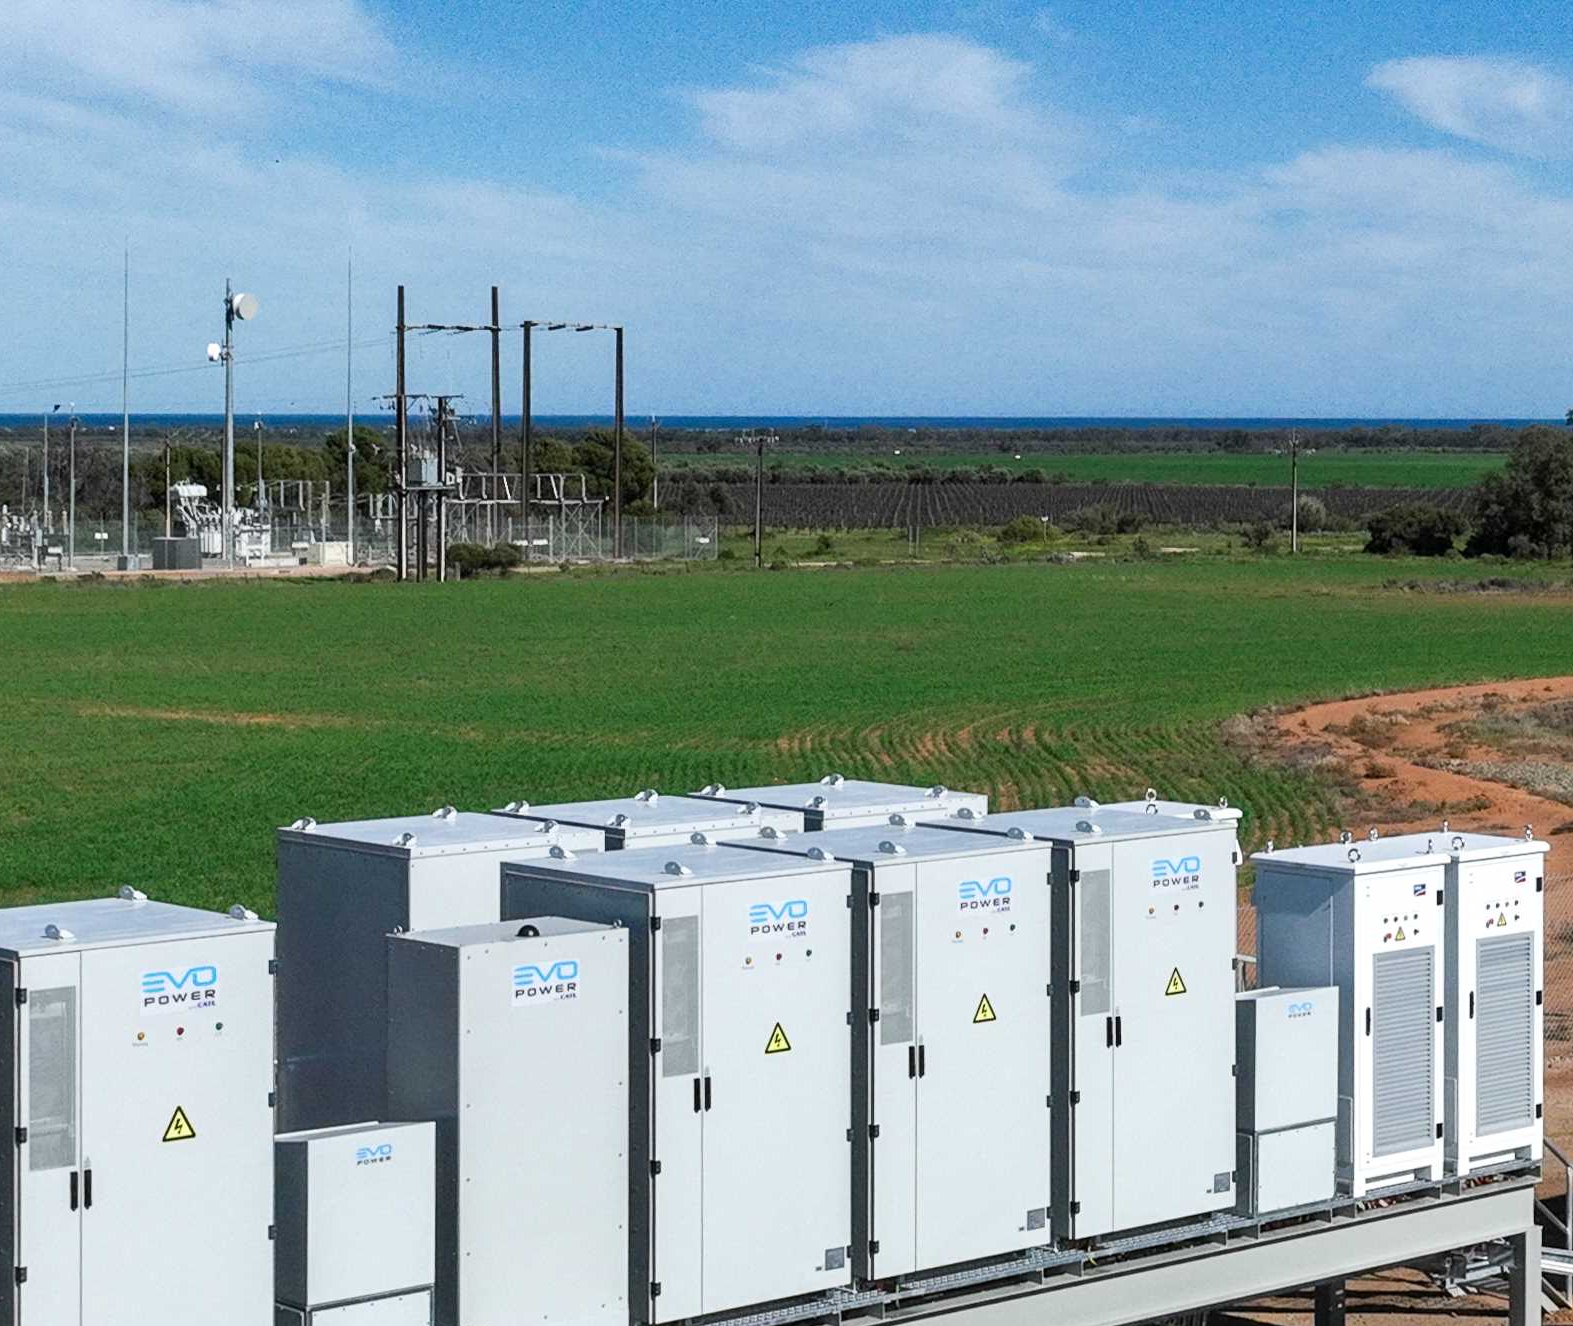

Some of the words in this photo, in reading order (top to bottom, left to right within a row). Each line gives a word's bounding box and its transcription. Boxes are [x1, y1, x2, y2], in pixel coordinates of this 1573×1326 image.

[1152, 856, 1201, 877] EVO
[959, 877, 1012, 899] EVO
[1153, 875, 1199, 888] POWER
[749, 900, 808, 923] EVO
[960, 897, 1011, 910] POWER
[751, 921, 807, 935] POWER
[142, 966, 217, 993] EVO
[514, 961, 577, 985] EVO
[144, 989, 216, 1007] POWER
[515, 982, 577, 999] POWER
[356, 1144, 392, 1159] EVO
